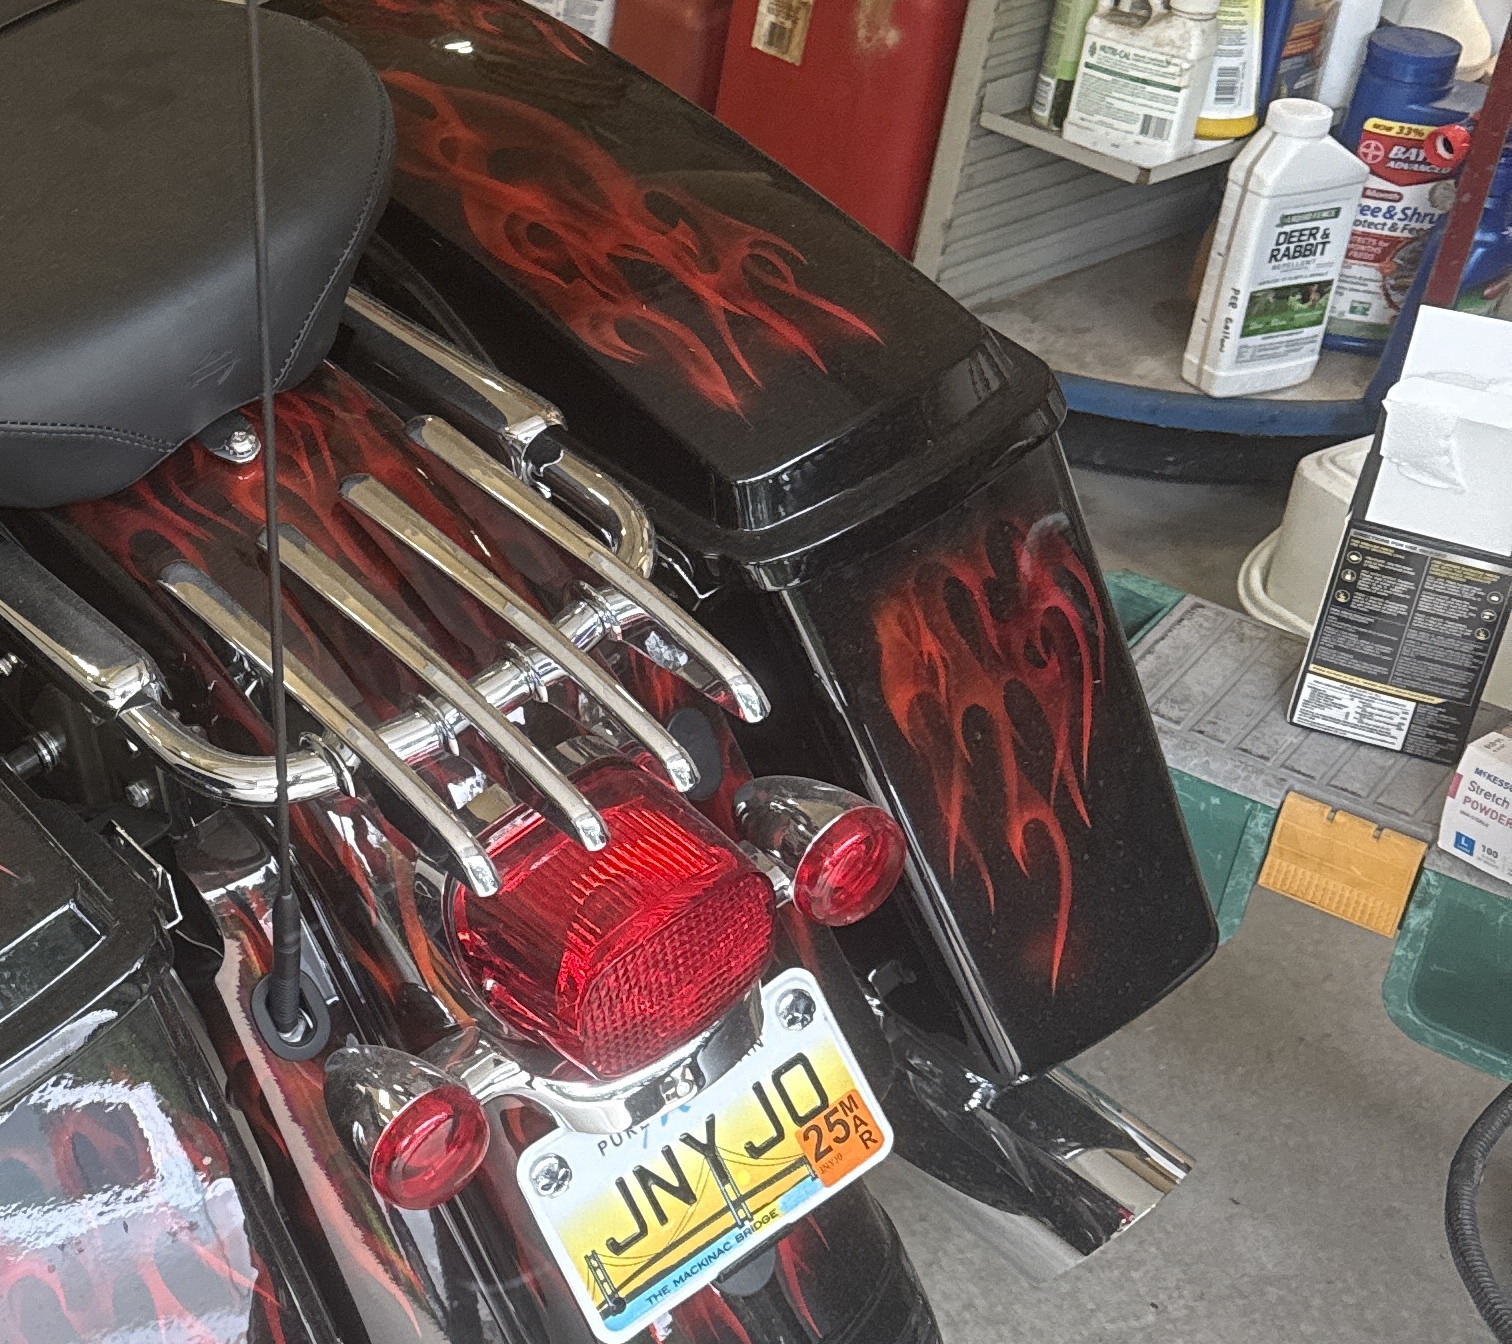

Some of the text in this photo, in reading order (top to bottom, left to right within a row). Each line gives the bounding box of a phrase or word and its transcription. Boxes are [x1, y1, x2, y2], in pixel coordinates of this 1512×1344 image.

[1396, 124, 1426, 138] 33%
[1389, 145, 1427, 162] BAY
[1353, 218, 1388, 232] otect
[1397, 206, 1441, 225] Shru
[1275, 226, 1331, 247] DEER &
[1268, 240, 1332, 264] RABBIT
[1473, 767, 1512, 793] McKESSO
[1467, 779, 1511, 810] Stretch
[1462, 794, 1512, 829] POWDER
[1481, 844, 1499, 859] 100
[803, 1106, 851, 1164] 25
[645, 1208, 780, 1307] THE MACKINAC BRIDGE
